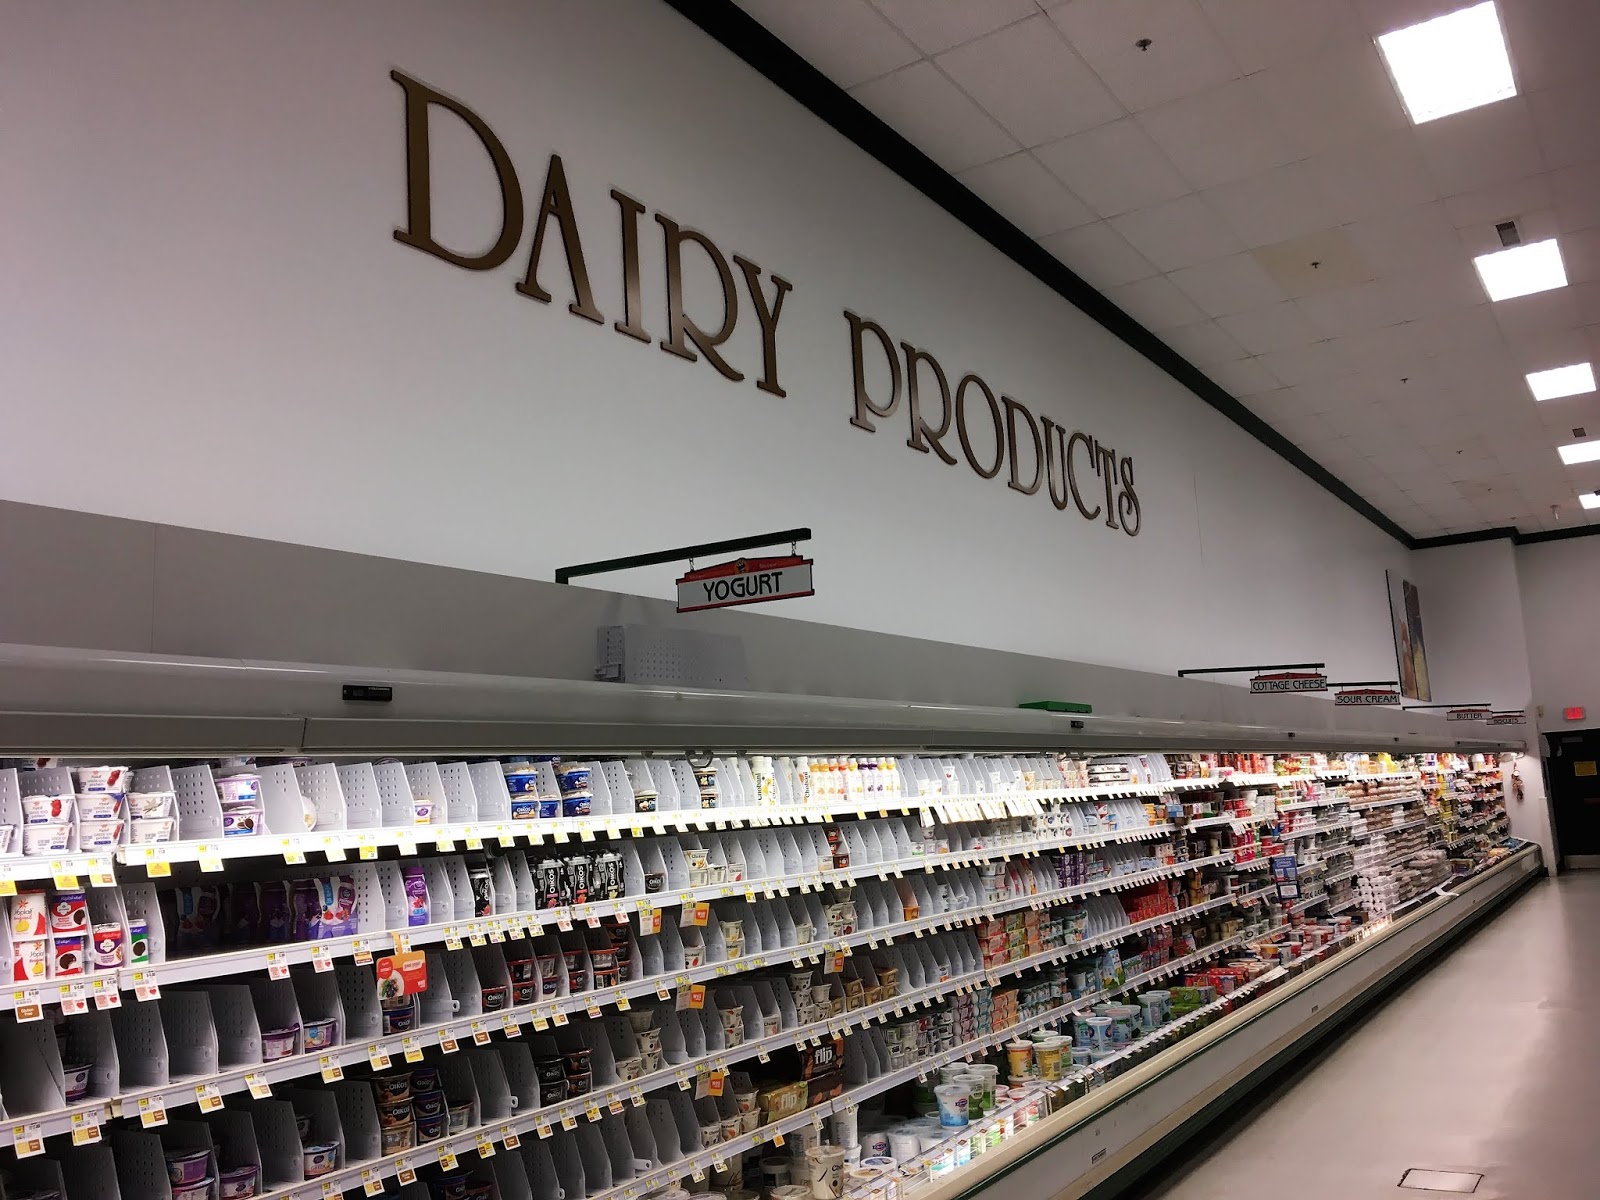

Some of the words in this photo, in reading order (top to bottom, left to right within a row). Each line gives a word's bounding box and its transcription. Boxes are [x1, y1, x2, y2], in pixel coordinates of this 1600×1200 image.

[390, 68, 792, 398] DAIRY
[843, 309, 1142, 537] PRODUCTS
[703, 571, 783, 602] YOGURT
[1252, 680, 1290, 691] COTTAGE
[1292, 678, 1325, 689] CHEESE
[1336, 695, 1362, 704] SOUR
[1365, 694, 1398, 703] CREAM
[14, 908, 33, 916] Yoplait
[814, 1046, 833, 1065] flip
[779, 1092, 797, 1110] flip
